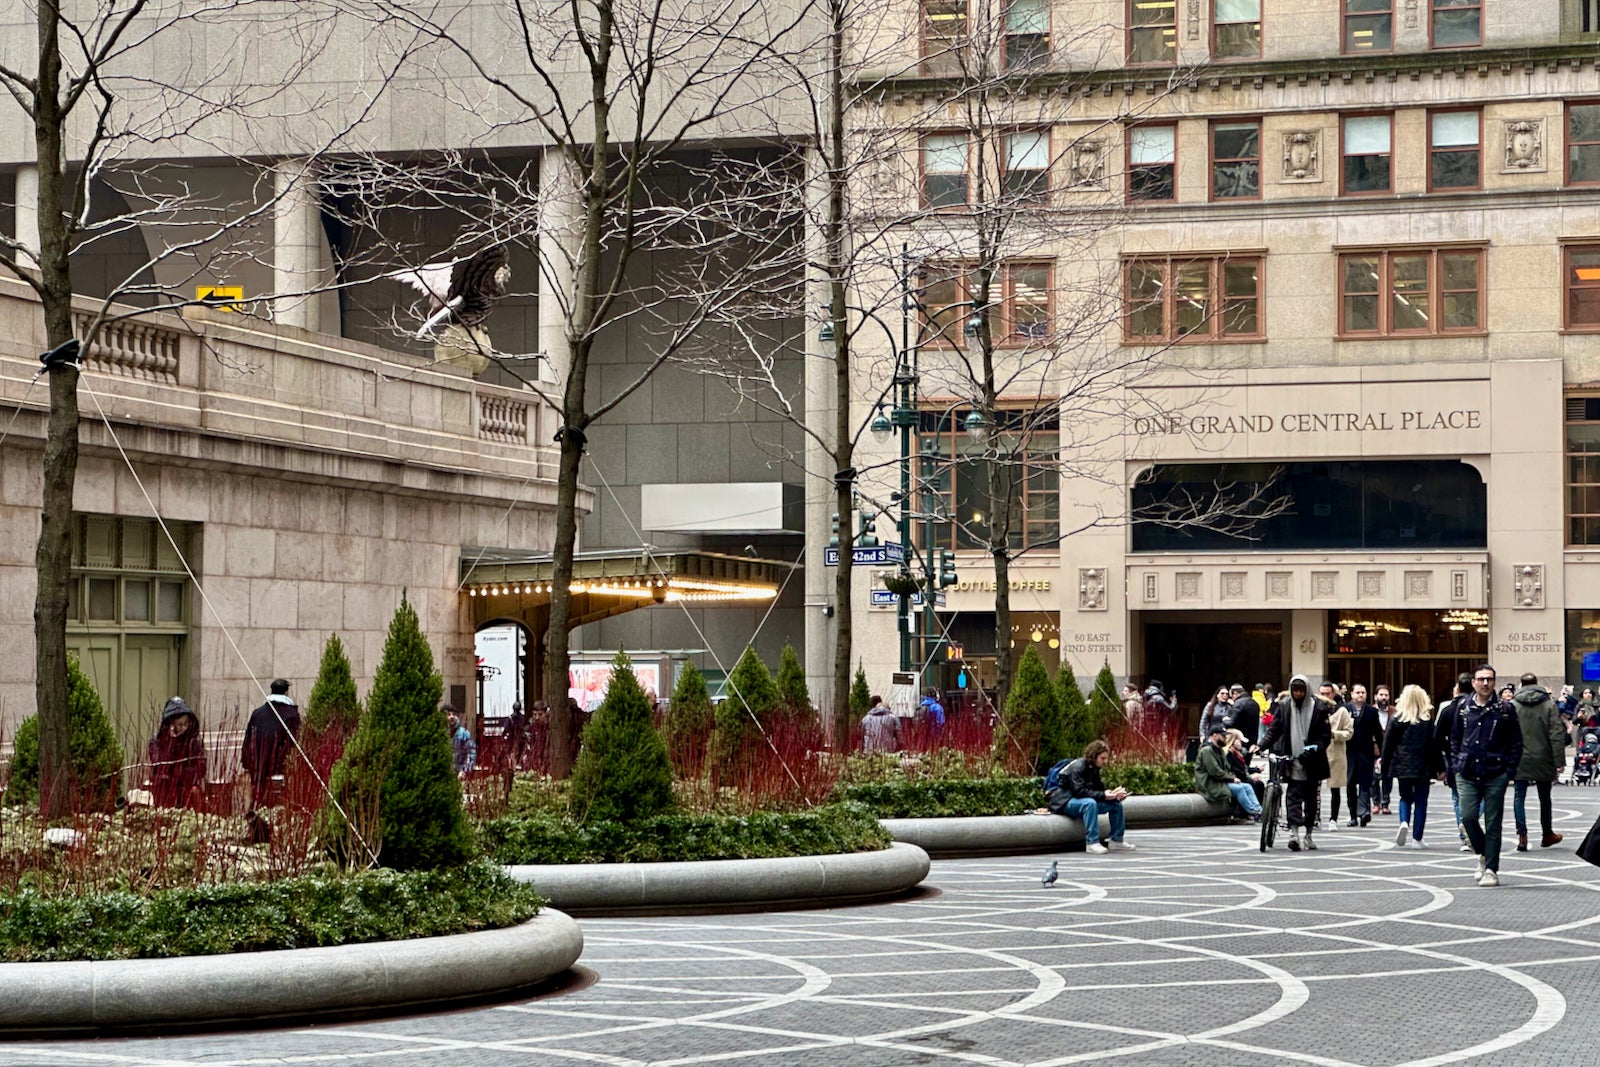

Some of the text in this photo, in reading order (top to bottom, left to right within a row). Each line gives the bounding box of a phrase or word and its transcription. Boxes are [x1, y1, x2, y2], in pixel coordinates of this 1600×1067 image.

[1134, 411, 1481, 434] ONE GRAND CENTRAL PLACE
[852, 551, 876, 561] 42nd
[1007, 580, 1051, 592] OFFEE
[874, 593, 890, 602] East
[1074, 633, 1111, 642] 60 EAST
[1508, 632, 1548, 641] 60 EAST
[1062, 644, 1123, 653] 42ND STREET
[1300, 639, 1317, 654] 60
[1495, 643, 1562, 653] 42ND STREET
